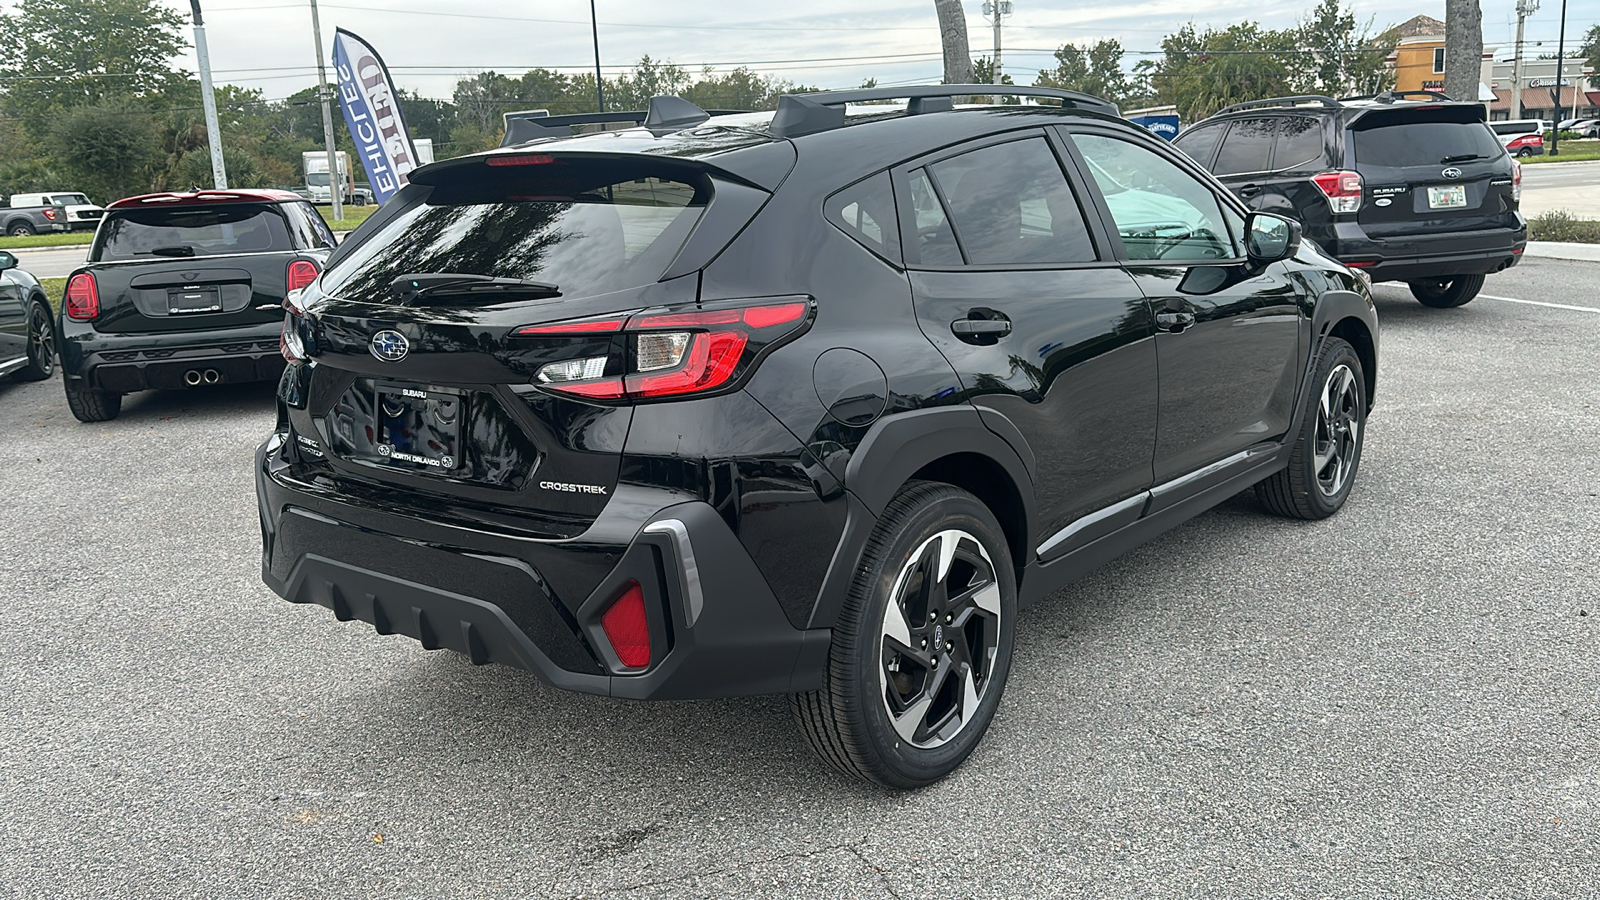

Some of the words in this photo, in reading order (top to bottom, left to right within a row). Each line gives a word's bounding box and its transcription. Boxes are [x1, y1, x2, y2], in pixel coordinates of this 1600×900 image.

[1373, 187, 1406, 195] SUBARU
[402, 388, 427, 399] SUBARU
[390, 451, 412, 462] NORTH
[412, 455, 440, 467] ORLANDO
[539, 481, 608, 495] CROSSTREK
